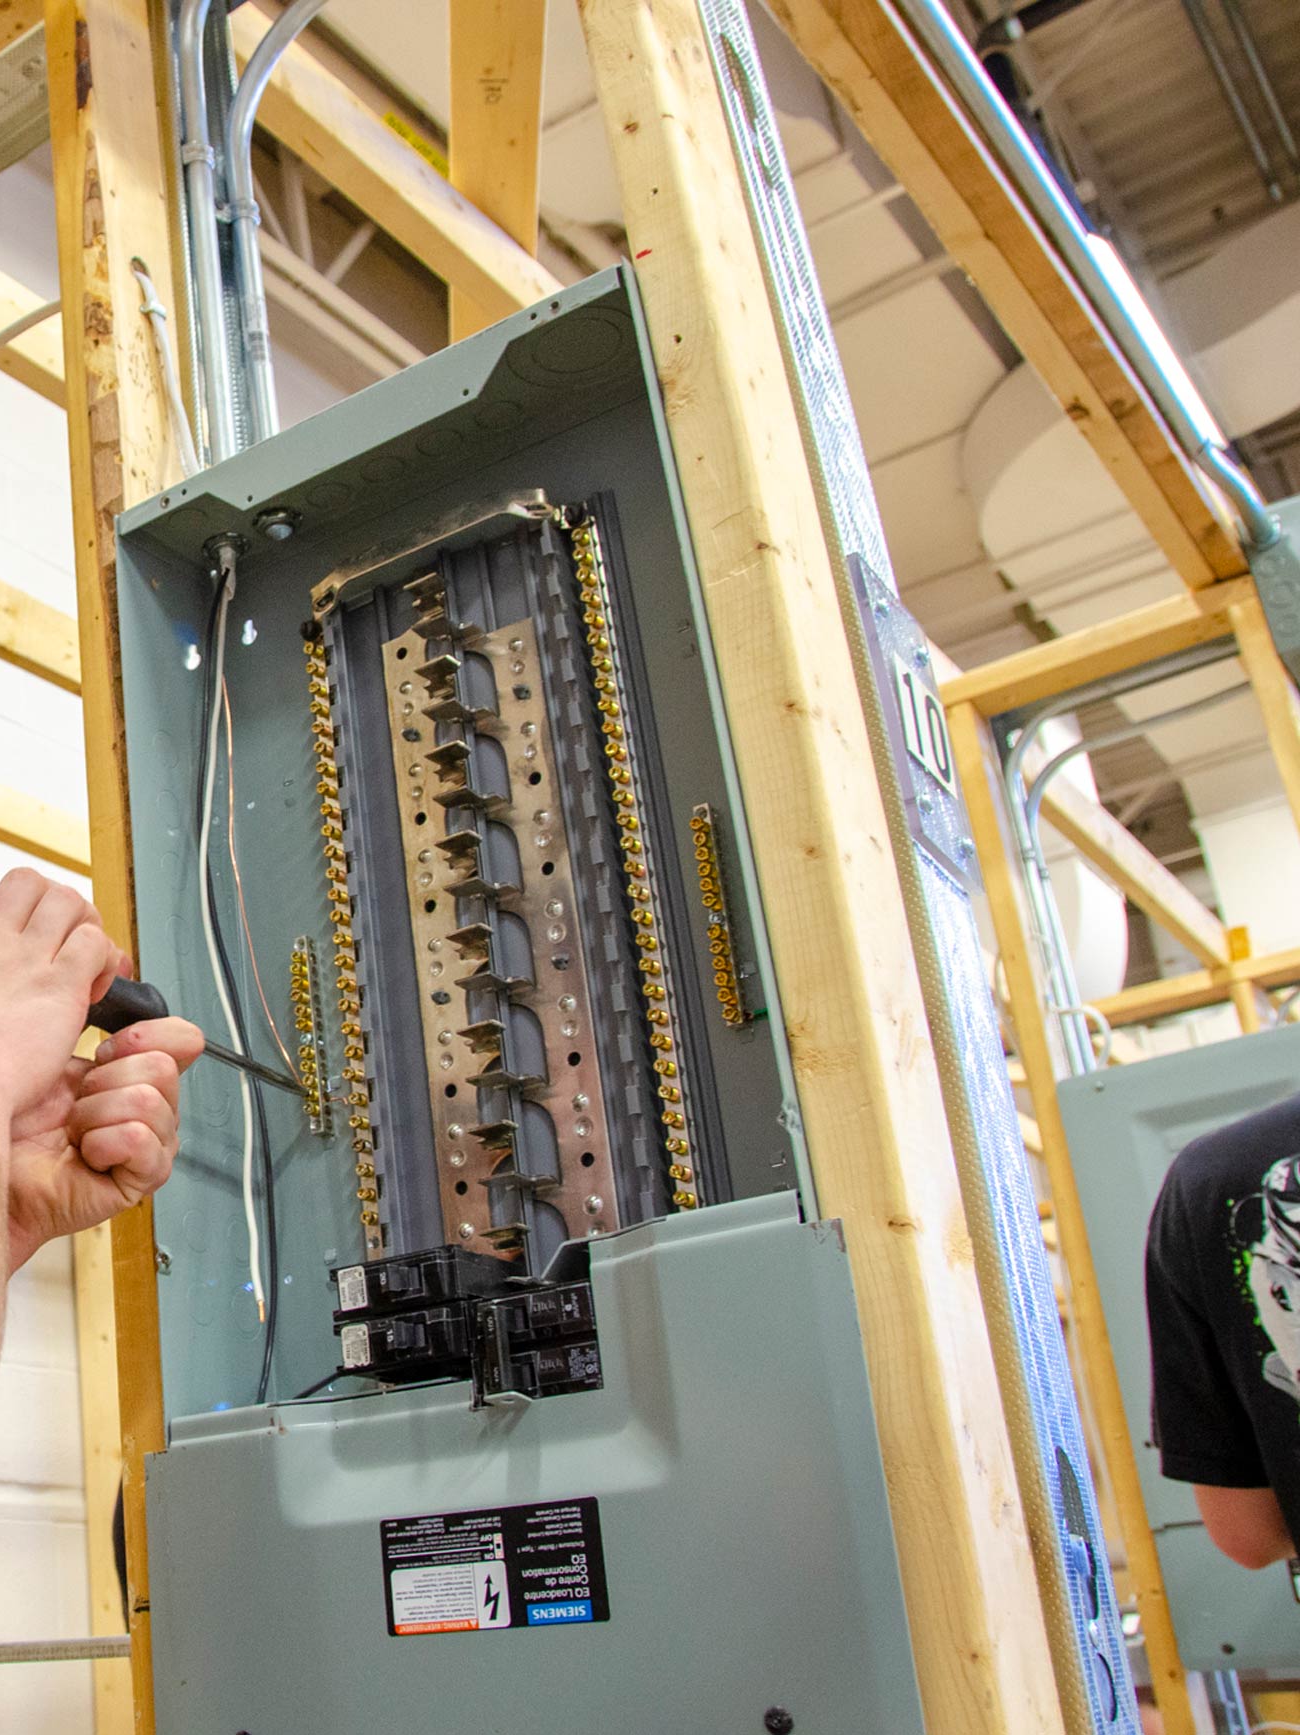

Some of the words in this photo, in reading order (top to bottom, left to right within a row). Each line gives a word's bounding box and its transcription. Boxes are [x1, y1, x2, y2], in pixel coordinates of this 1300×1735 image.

[902, 671, 952, 783] 10
[521, 1544, 534, 1552] Type
[570, 1553, 586, 1563] EQ
[521, 1564, 588, 1578] Consommation
[544, 1577, 557, 1586] de
[558, 1574, 589, 1585] Centre
[523, 1588, 573, 1601] Loadcentre
[574, 1587, 590, 1597] EQ
[532, 1605, 586, 1619] SIEMENS
